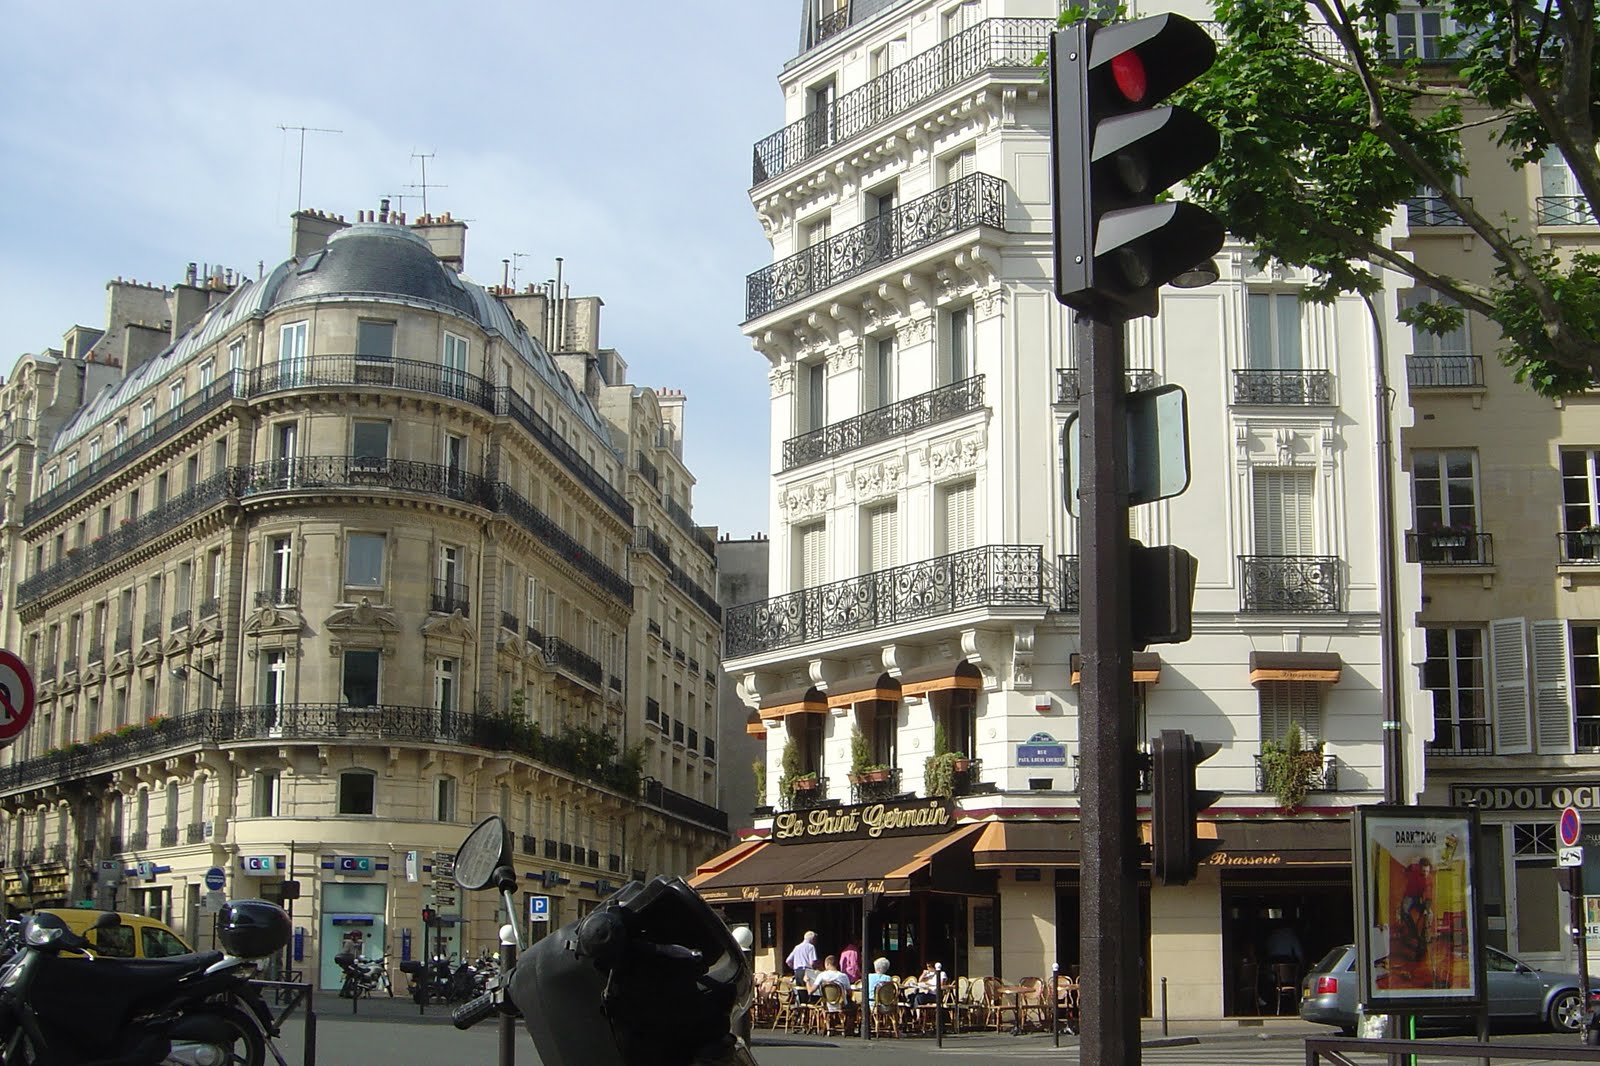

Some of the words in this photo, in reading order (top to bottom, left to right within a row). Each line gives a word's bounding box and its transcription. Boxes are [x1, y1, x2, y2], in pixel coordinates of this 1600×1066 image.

[776, 812, 805, 839] Le
[807, 809, 860, 836] Saint
[862, 800, 950, 838] Germain
[1395, 831, 1415, 844] DARK
[1420, 831, 1437, 844] DOG
[250, 858, 269, 869] CIC
[342, 858, 369, 870] CIC
[1209, 851, 1281, 865] Brasserie
[783, 884, 822, 897] Brasserie
[846, 880, 886, 895] Coctails
[535, 900, 544, 911] P
